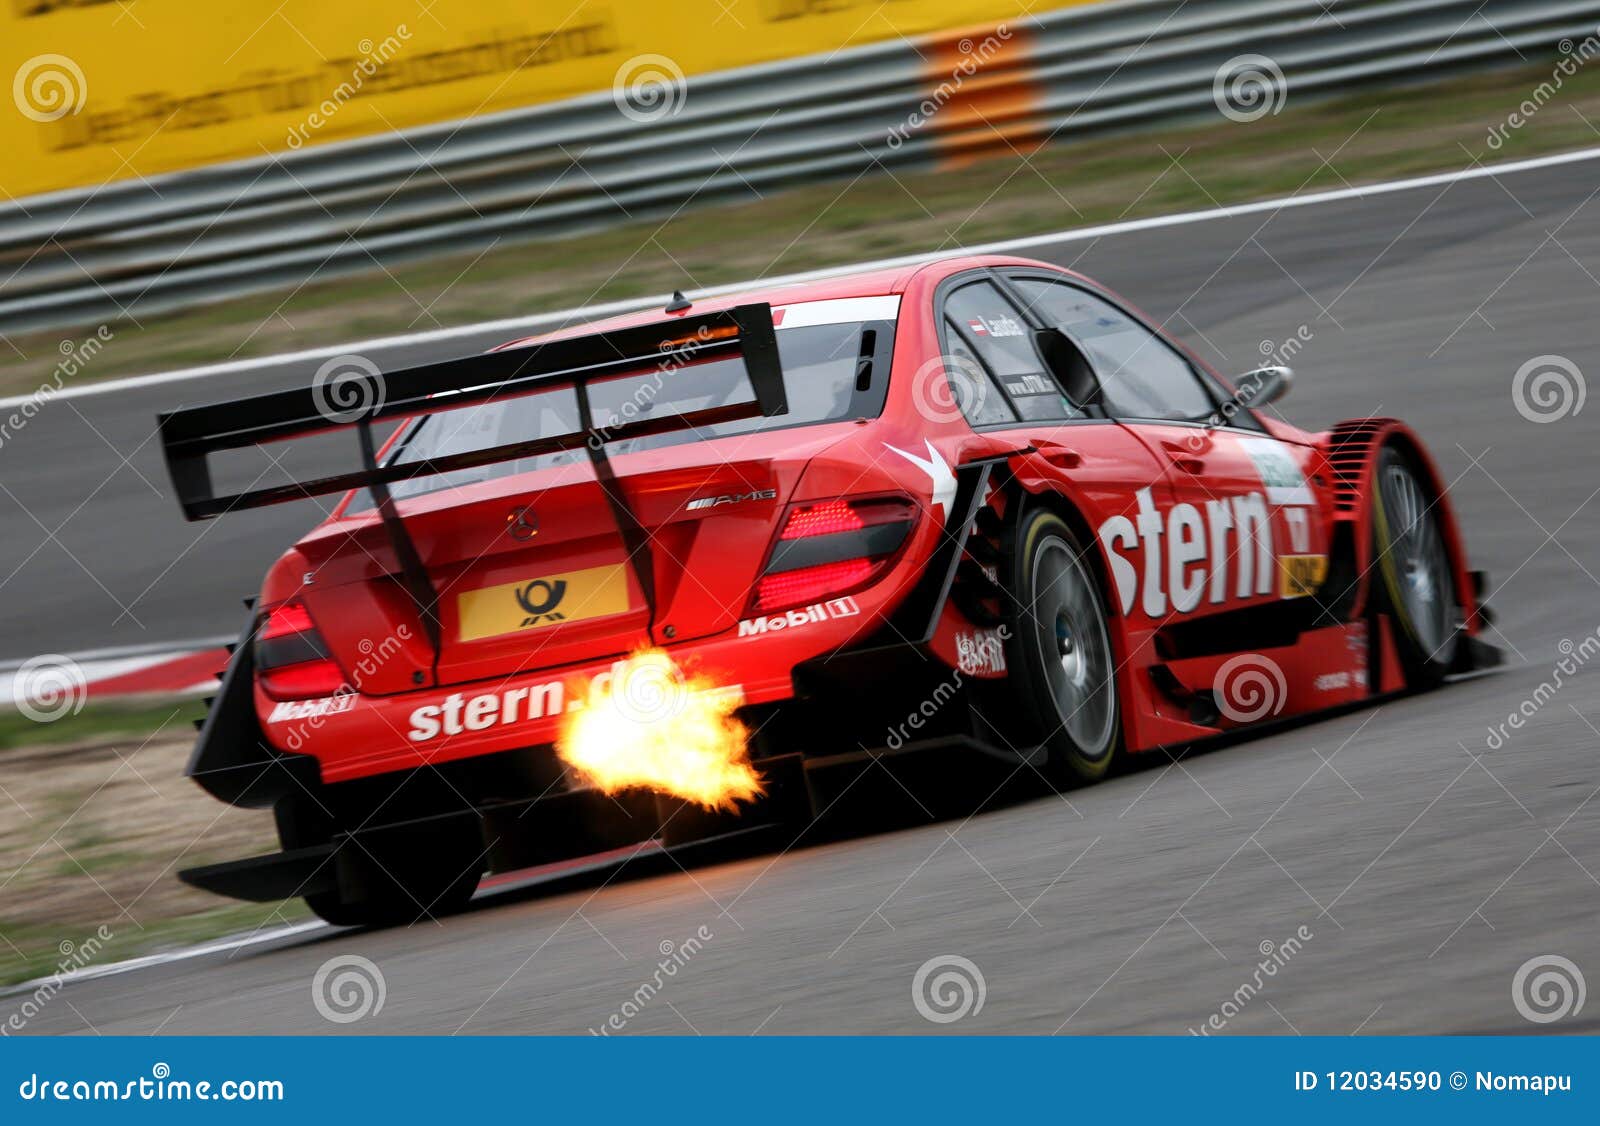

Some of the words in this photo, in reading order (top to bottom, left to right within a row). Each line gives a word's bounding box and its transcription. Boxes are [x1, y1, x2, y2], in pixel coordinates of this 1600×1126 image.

[713, 489, 777, 507] AMG
[1098, 487, 1274, 618] stern
[737, 604, 827, 637] Mobil
